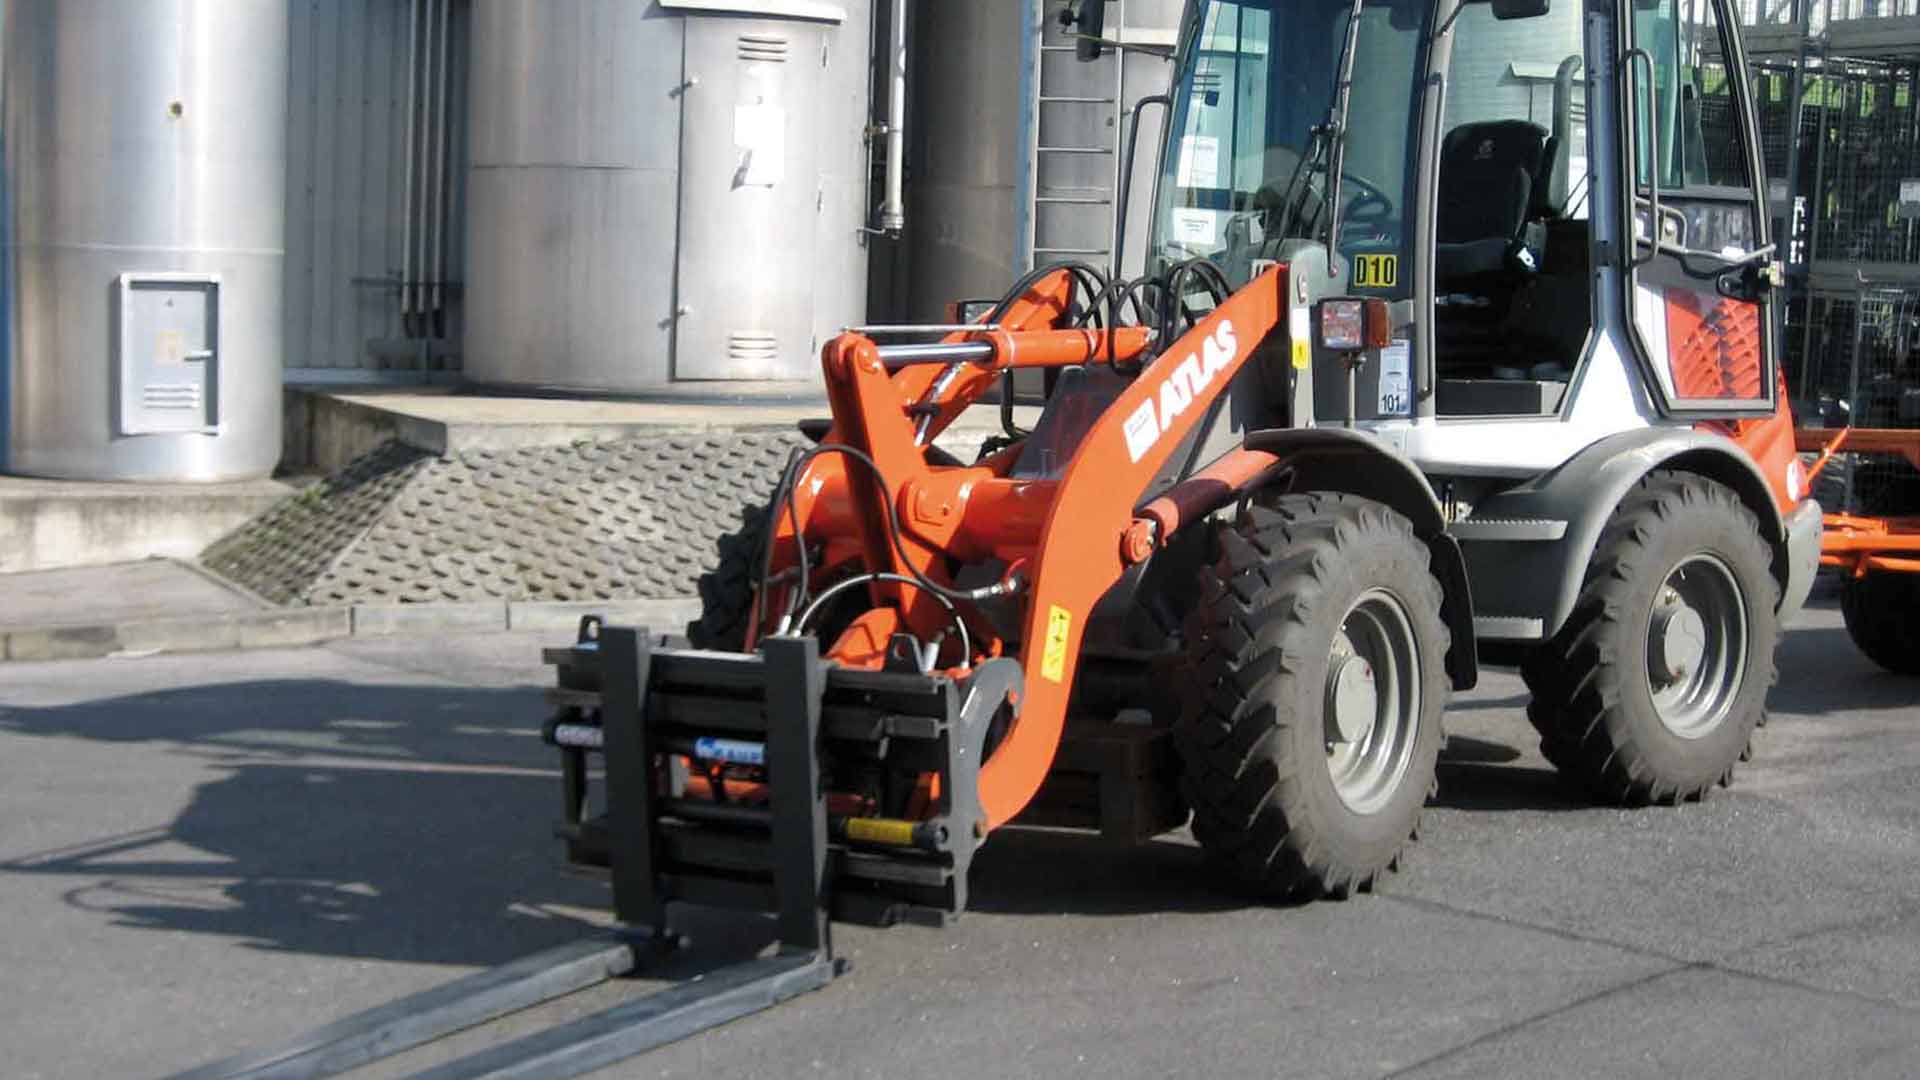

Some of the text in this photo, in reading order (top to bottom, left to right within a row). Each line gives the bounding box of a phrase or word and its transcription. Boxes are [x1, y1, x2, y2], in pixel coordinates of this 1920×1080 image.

[1356, 256, 1394, 284] D10
[1159, 319, 1237, 432] ATLAS
[1382, 394, 1400, 412] 101
